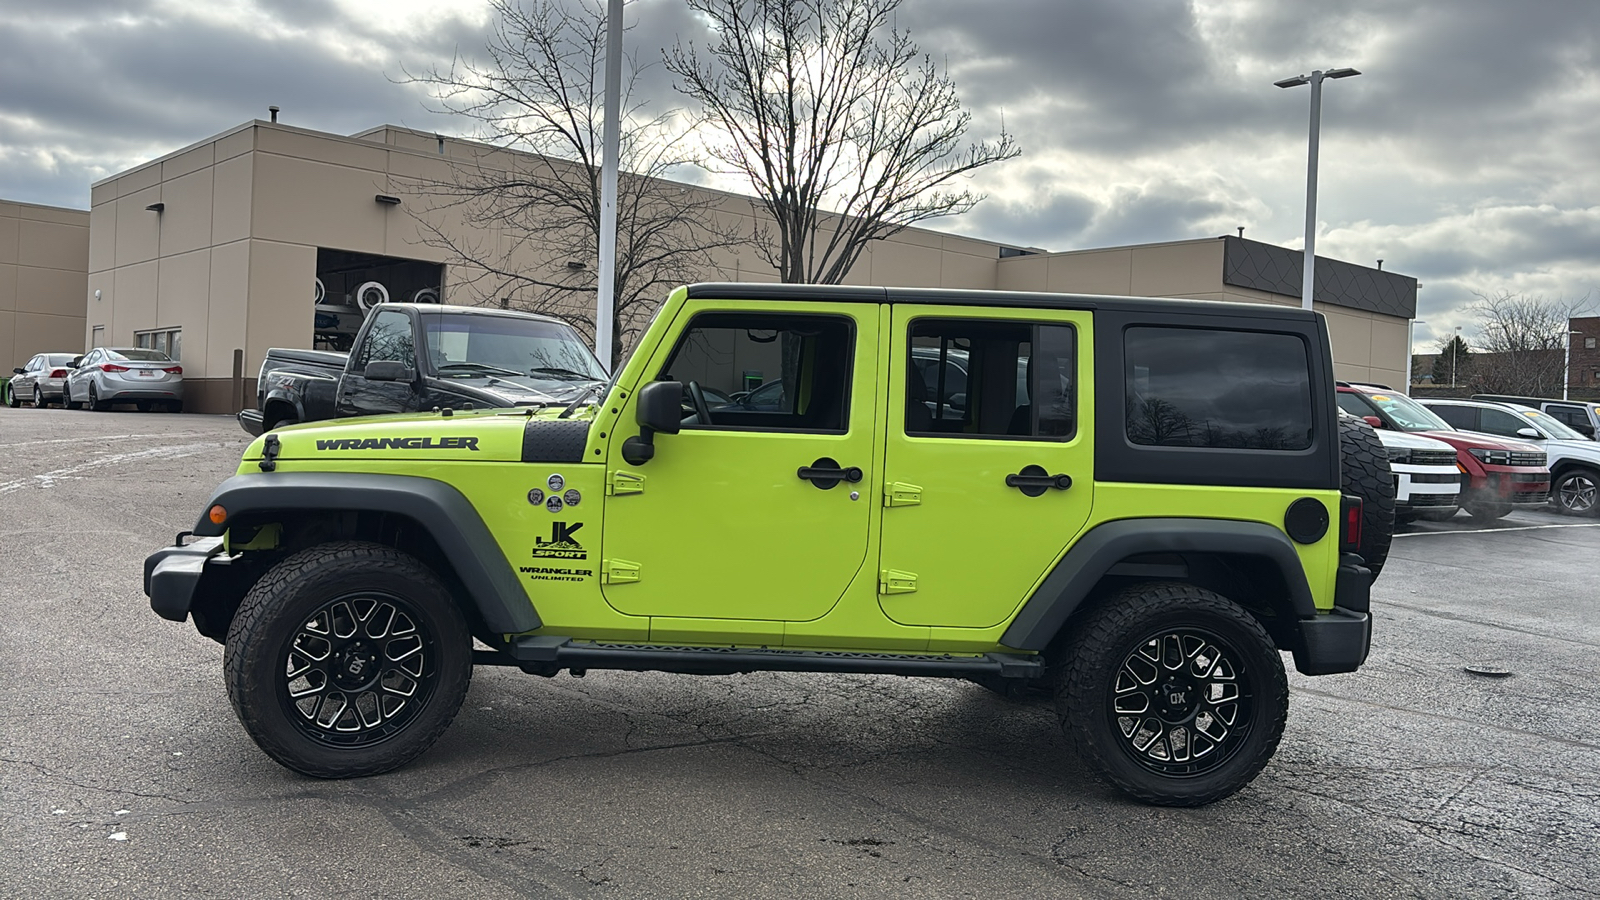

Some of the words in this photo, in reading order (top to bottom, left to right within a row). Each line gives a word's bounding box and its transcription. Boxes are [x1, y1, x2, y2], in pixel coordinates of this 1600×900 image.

[316, 436, 480, 451] WRANGLER
[536, 521, 583, 549] JK
[535, 550, 584, 558] SPORT
[519, 567, 593, 576] WRANGLER
